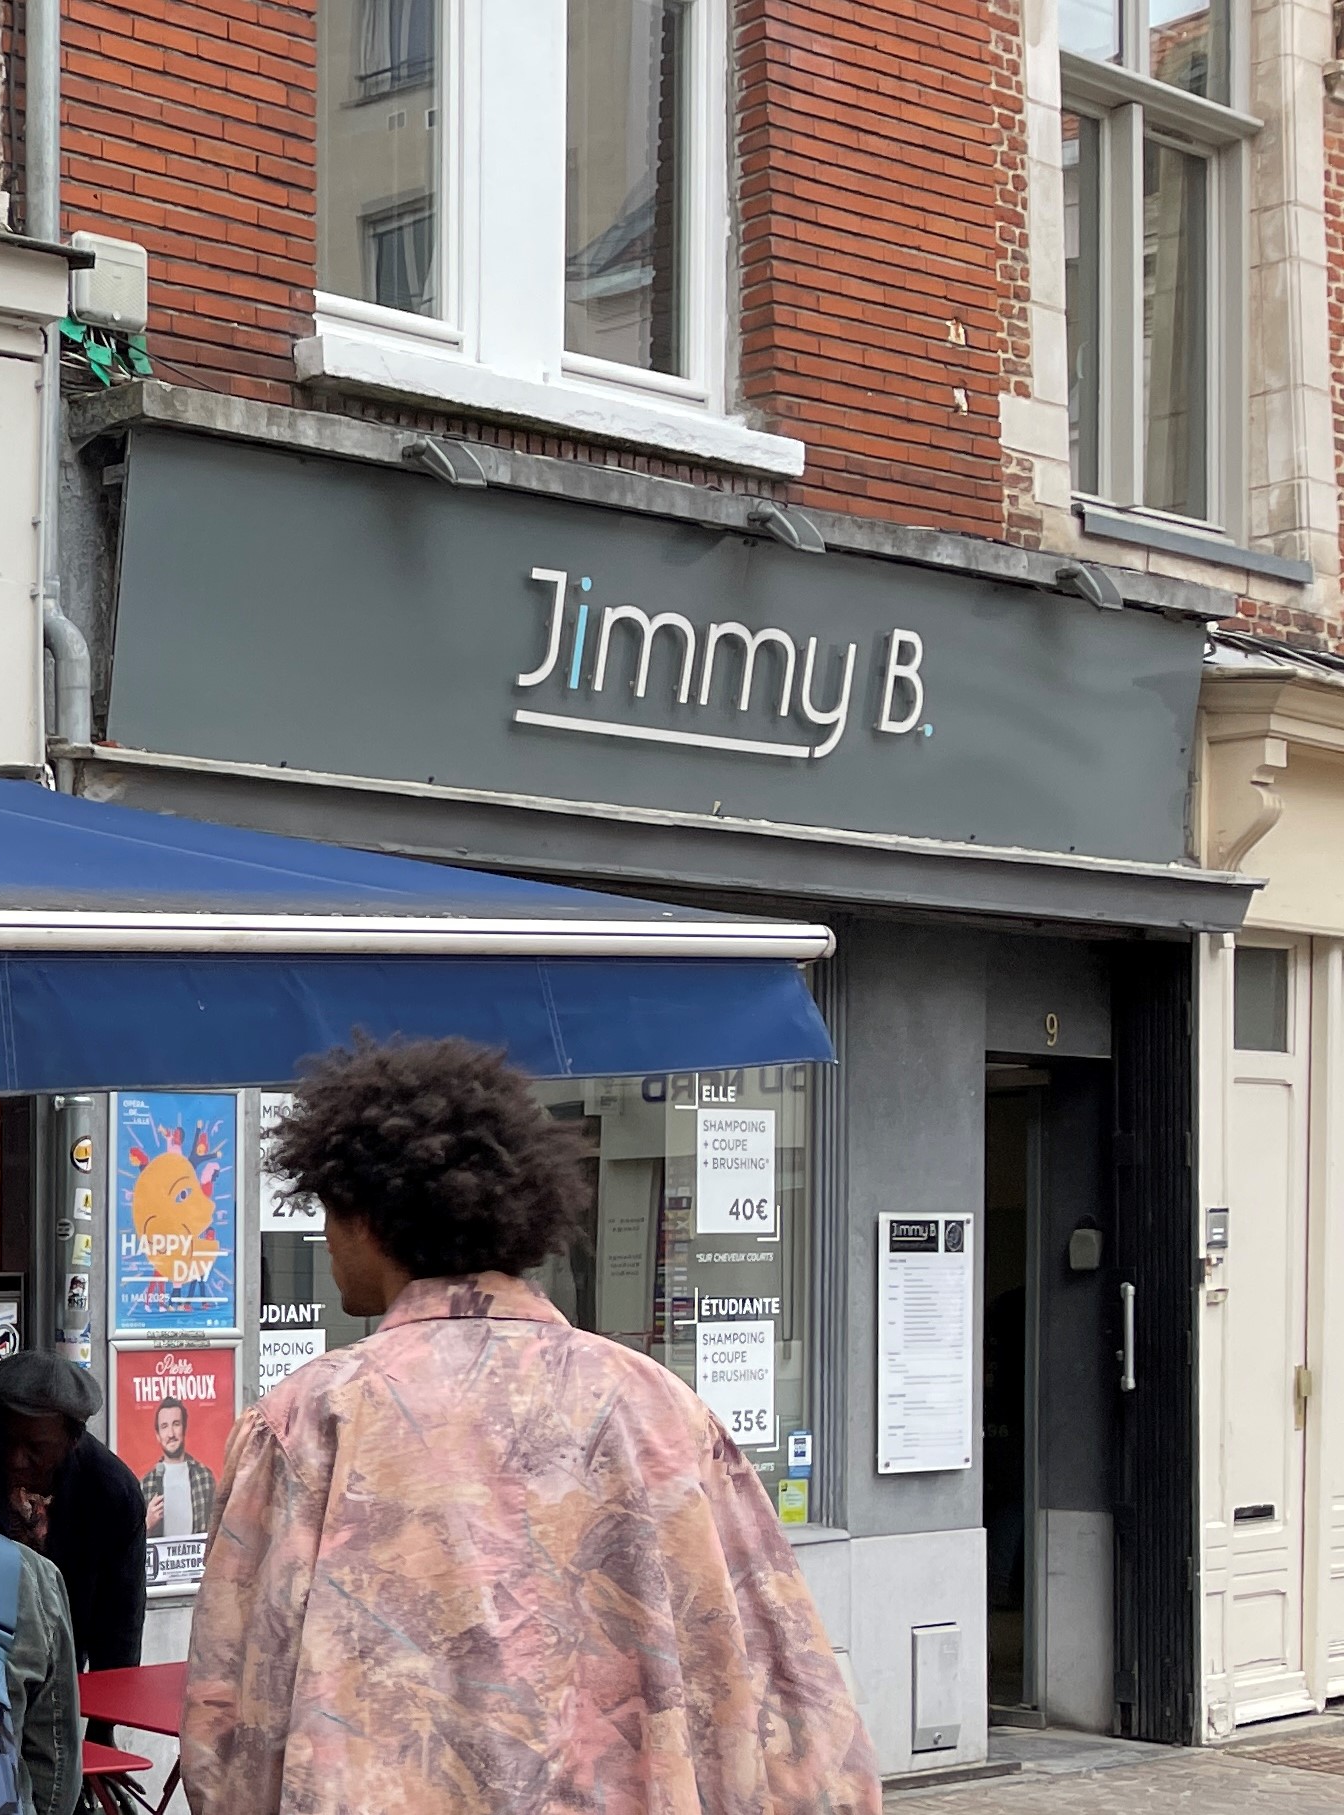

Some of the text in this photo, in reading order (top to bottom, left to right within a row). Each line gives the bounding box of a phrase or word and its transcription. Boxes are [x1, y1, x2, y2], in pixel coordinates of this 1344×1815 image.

[515, 567, 857, 758] Jimmy
[1046, 1012, 1060, 1047] 9
[703, 1086, 736, 1102] ELLE
[703, 1120, 766, 1132] SHAMPOING
[712, 1138, 748, 1151] COUPE
[729, 1198, 768, 1221] 40€
[121, 1233, 193, 1256] HAPPY
[173, 1260, 213, 1282] DAY
[260, 1303, 326, 1323] UDIANT
[701, 1296, 780, 1316] ÉTUDIANTE
[703, 1332, 765, 1345] SHAMPOING
[260, 1342, 314, 1356] MPOING
[712, 1351, 747, 1364] COUPE
[260, 1364, 291, 1377] OUPE
[133, 1375, 216, 1402] THEVENOUX
[732, 1409, 767, 1432] 35€
[167, 1543, 201, 1557] THÉÂTRE
